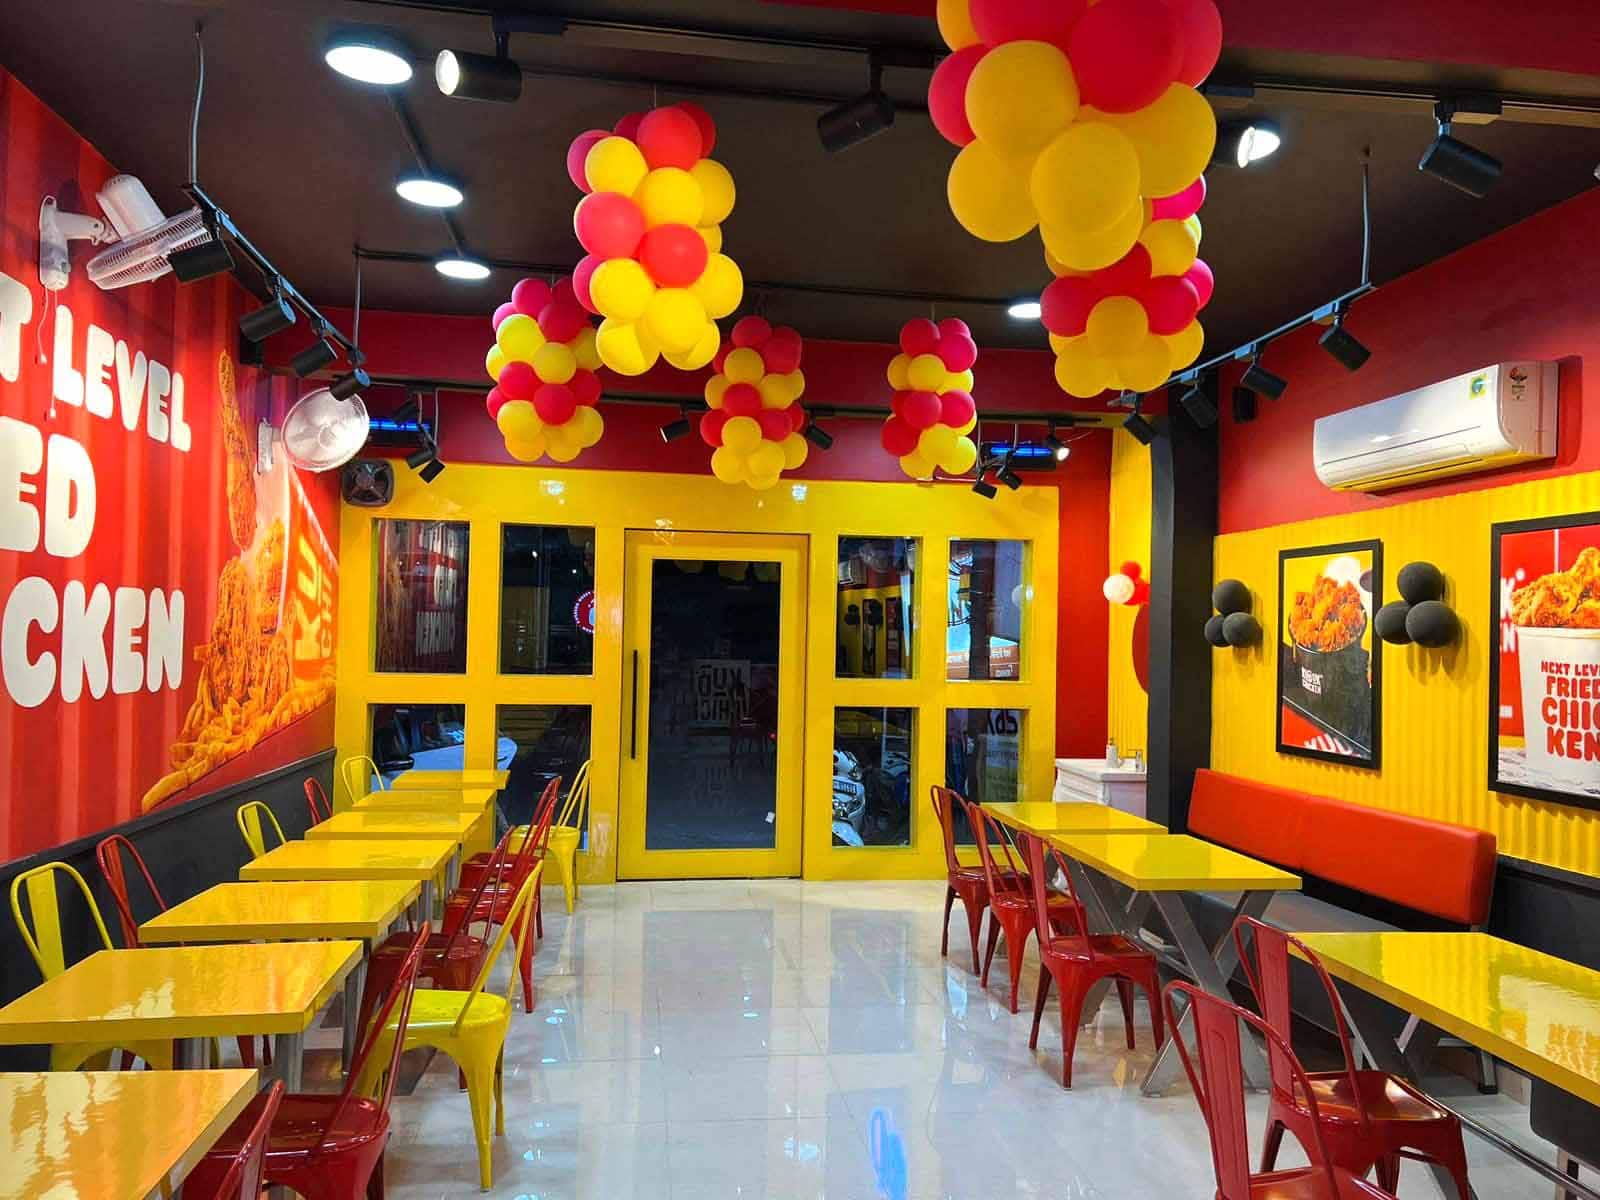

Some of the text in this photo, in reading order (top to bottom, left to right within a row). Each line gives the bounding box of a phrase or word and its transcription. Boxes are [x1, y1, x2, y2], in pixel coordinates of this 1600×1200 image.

[53, 304, 191, 452] LEVEL
[0, 415, 96, 558] ED
[1, 576, 185, 708] CKEN
[1541, 661, 1600, 677] NEXT LEV
[1547, 727, 1600, 762] KEN
